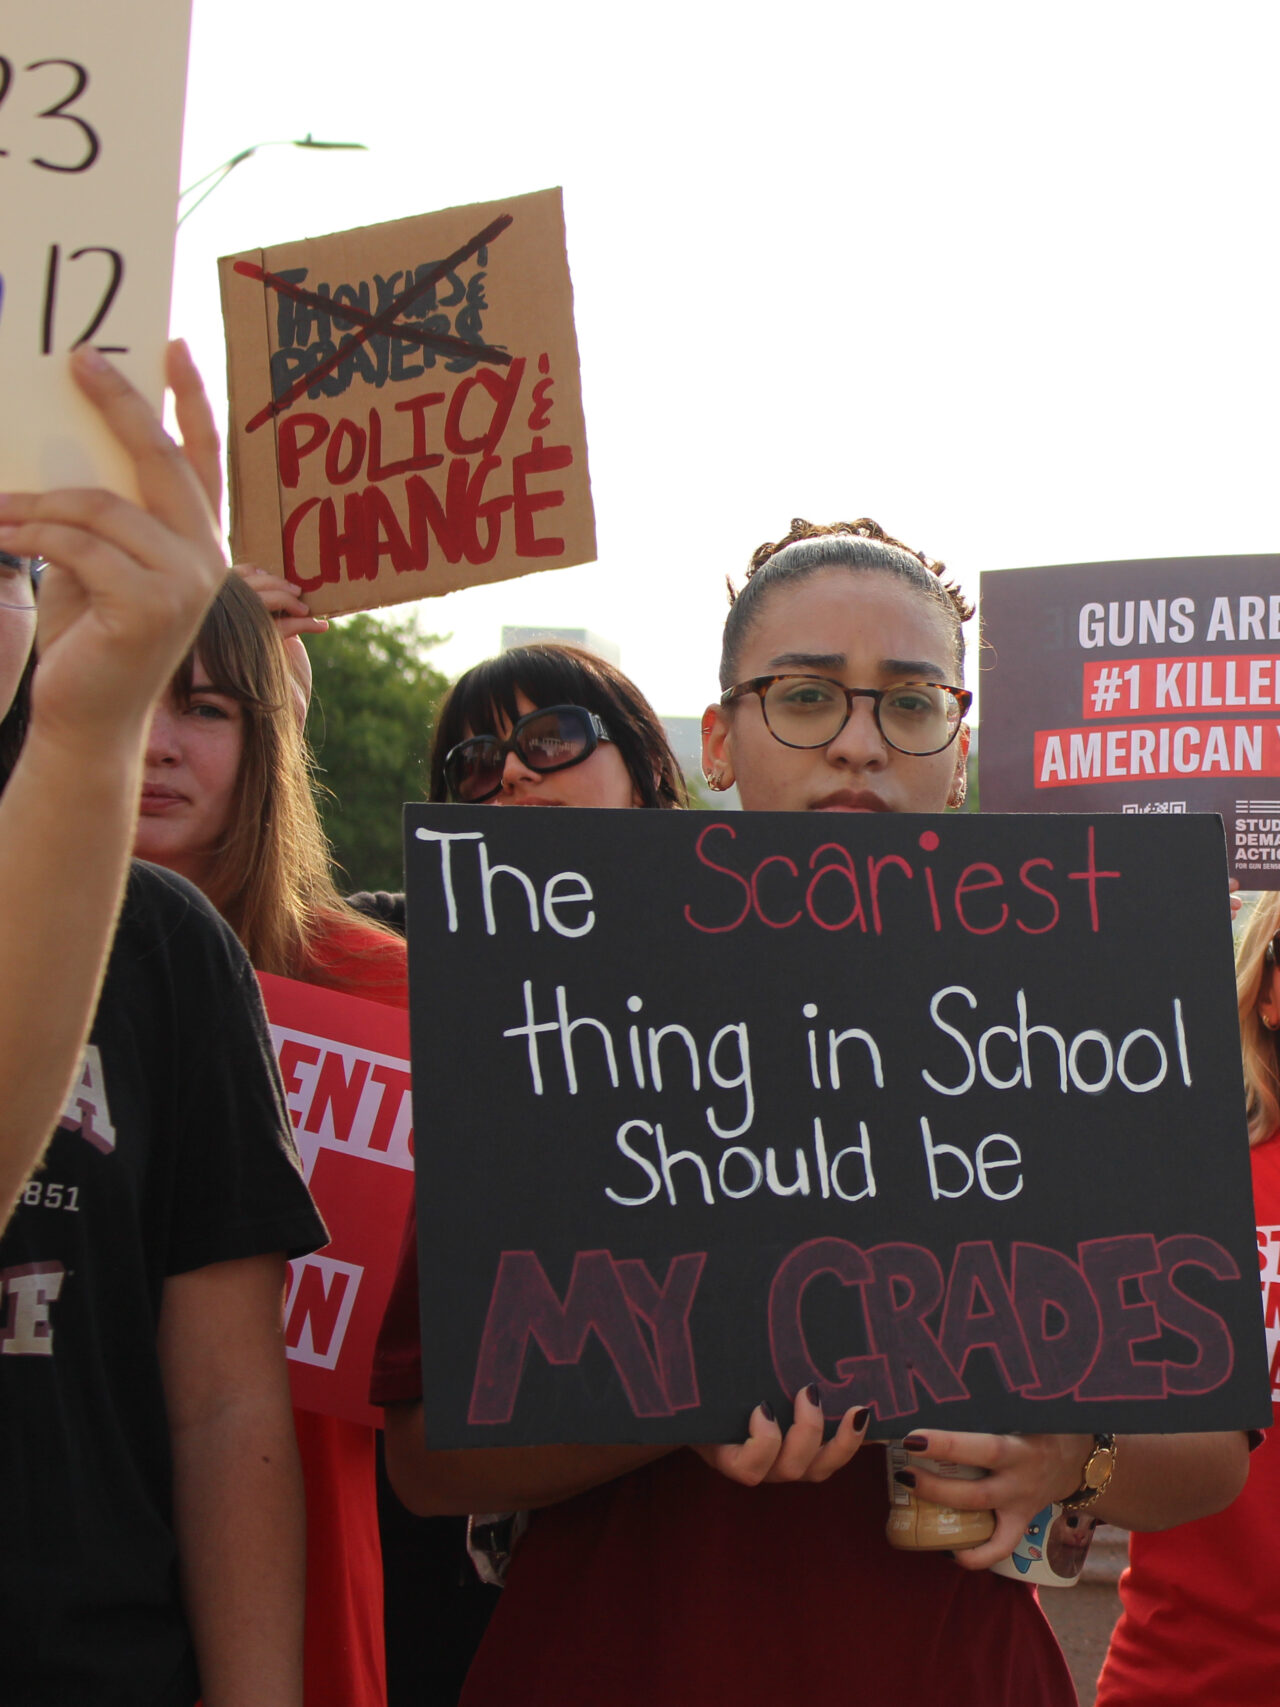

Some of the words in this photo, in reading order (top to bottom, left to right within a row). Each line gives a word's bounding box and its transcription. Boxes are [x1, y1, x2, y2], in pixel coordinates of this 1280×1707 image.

[41, 243, 129, 355] 12
[278, 357, 526, 488] POLICY
[283, 446, 573, 593] CHANGE
[1078, 597, 1195, 648] GUNS
[1091, 664, 1140, 712] #1
[1040, 725, 1262, 782] AMERICAN
[416, 827, 595, 937] The
[684, 823, 1121, 934] Scariest
[1235, 862, 1248, 870] FOR
[1248, 862, 1262, 870] GUN
[278, 1039, 414, 1158] ENT
[503, 980, 755, 1138] thing
[803, 1002, 884, 1091] in
[921, 985, 1192, 1095] School
[23, 1181, 80, 1212] 851
[605, 1117, 876, 1205] Should
[920, 1116, 1024, 1202] be
[0, 1260, 65, 1355] E
[285, 1261, 350, 1357] N
[467, 1249, 707, 1425] MY
[768, 1233, 1241, 1421] GRADES
